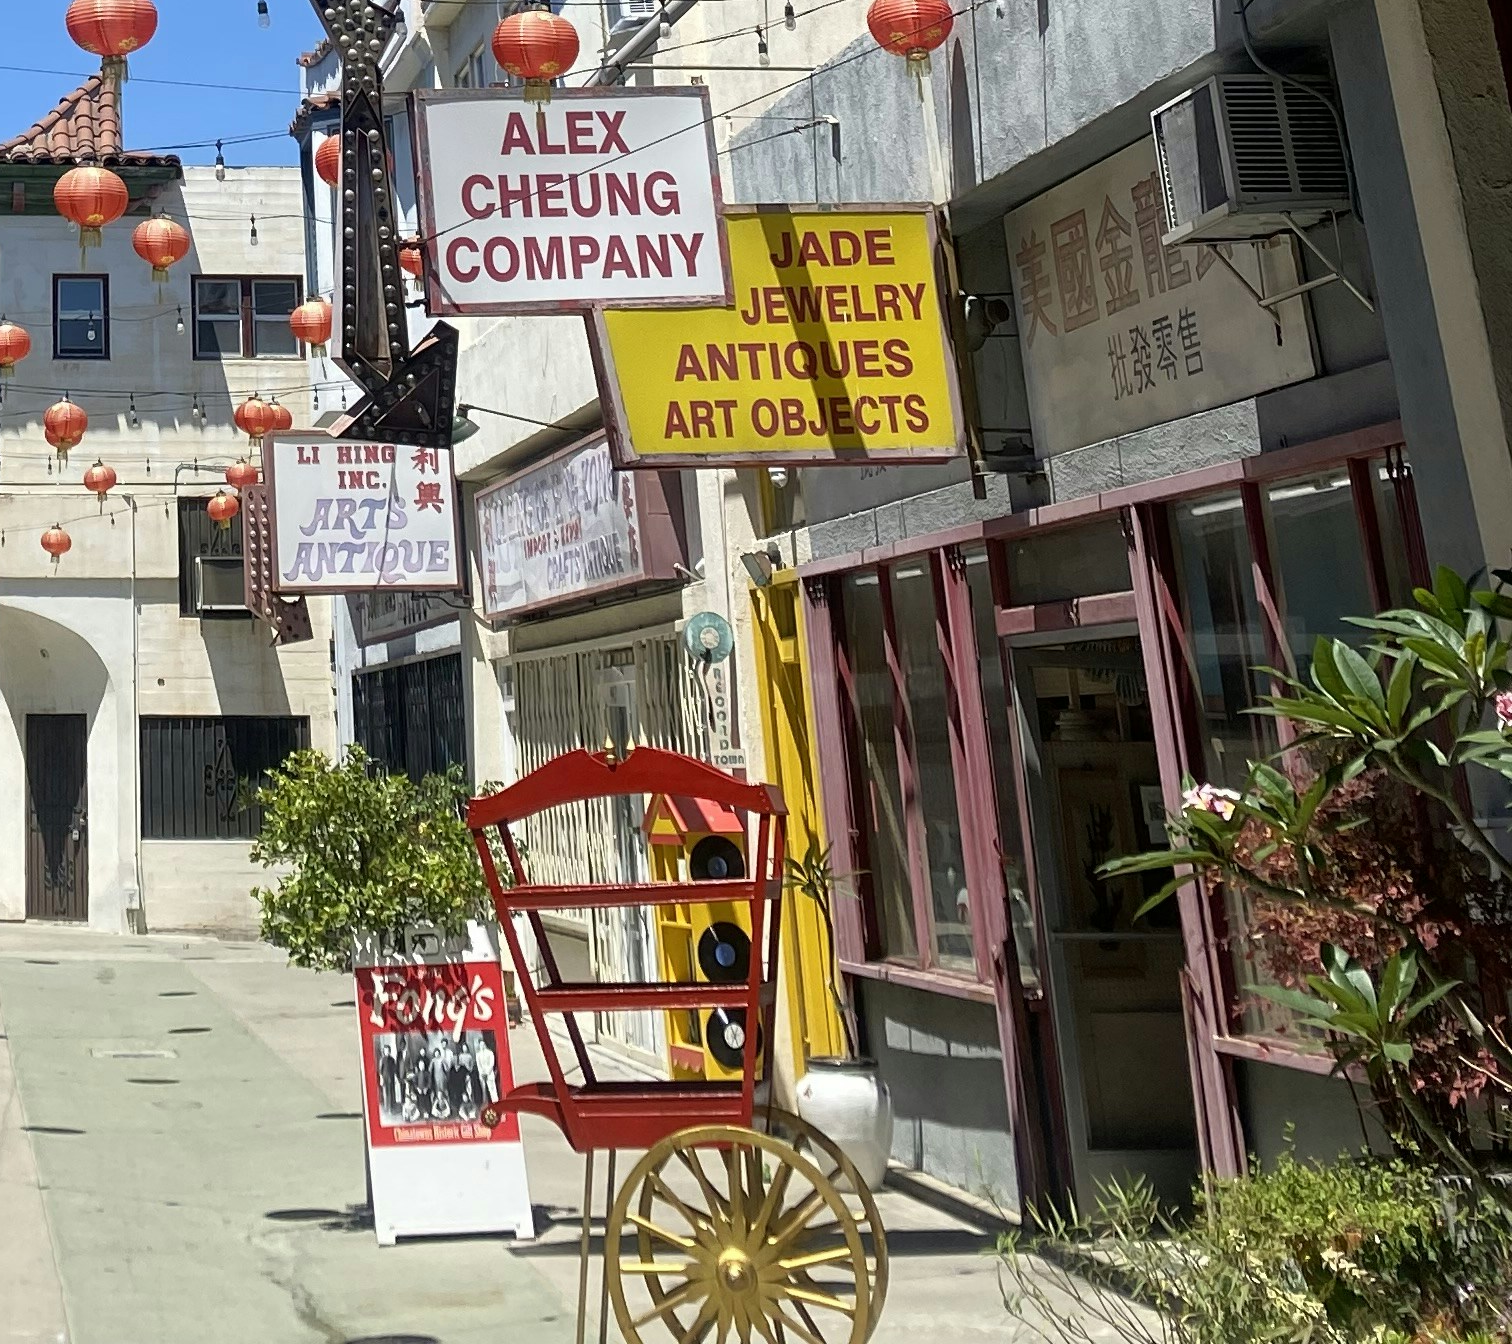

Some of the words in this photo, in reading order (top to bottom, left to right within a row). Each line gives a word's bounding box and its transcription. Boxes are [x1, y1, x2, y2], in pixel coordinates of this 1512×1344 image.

[501, 111, 630, 156] ALEX
[461, 170, 681, 220] CHEUNG
[446, 232, 704, 283] COMPANY
[770, 229, 896, 269] JADE
[740, 283, 926, 326] JEWELRY
[674, 339, 914, 382] ANTIQUES
[1107, 307, 1204, 401] 批發零售
[664, 399, 738, 439] ART
[750, 394, 930, 438] OBJECTS
[296, 446, 320, 465] LI
[337, 445, 396, 464] HING
[338, 470, 387, 490] INC.
[410, 446, 445, 514] 利興
[299, 497, 408, 539] ARTS
[283, 539, 450, 584] ANTIQUE
[714, 755, 745, 766] TOWN
[370, 971, 495, 1043] Fong's
